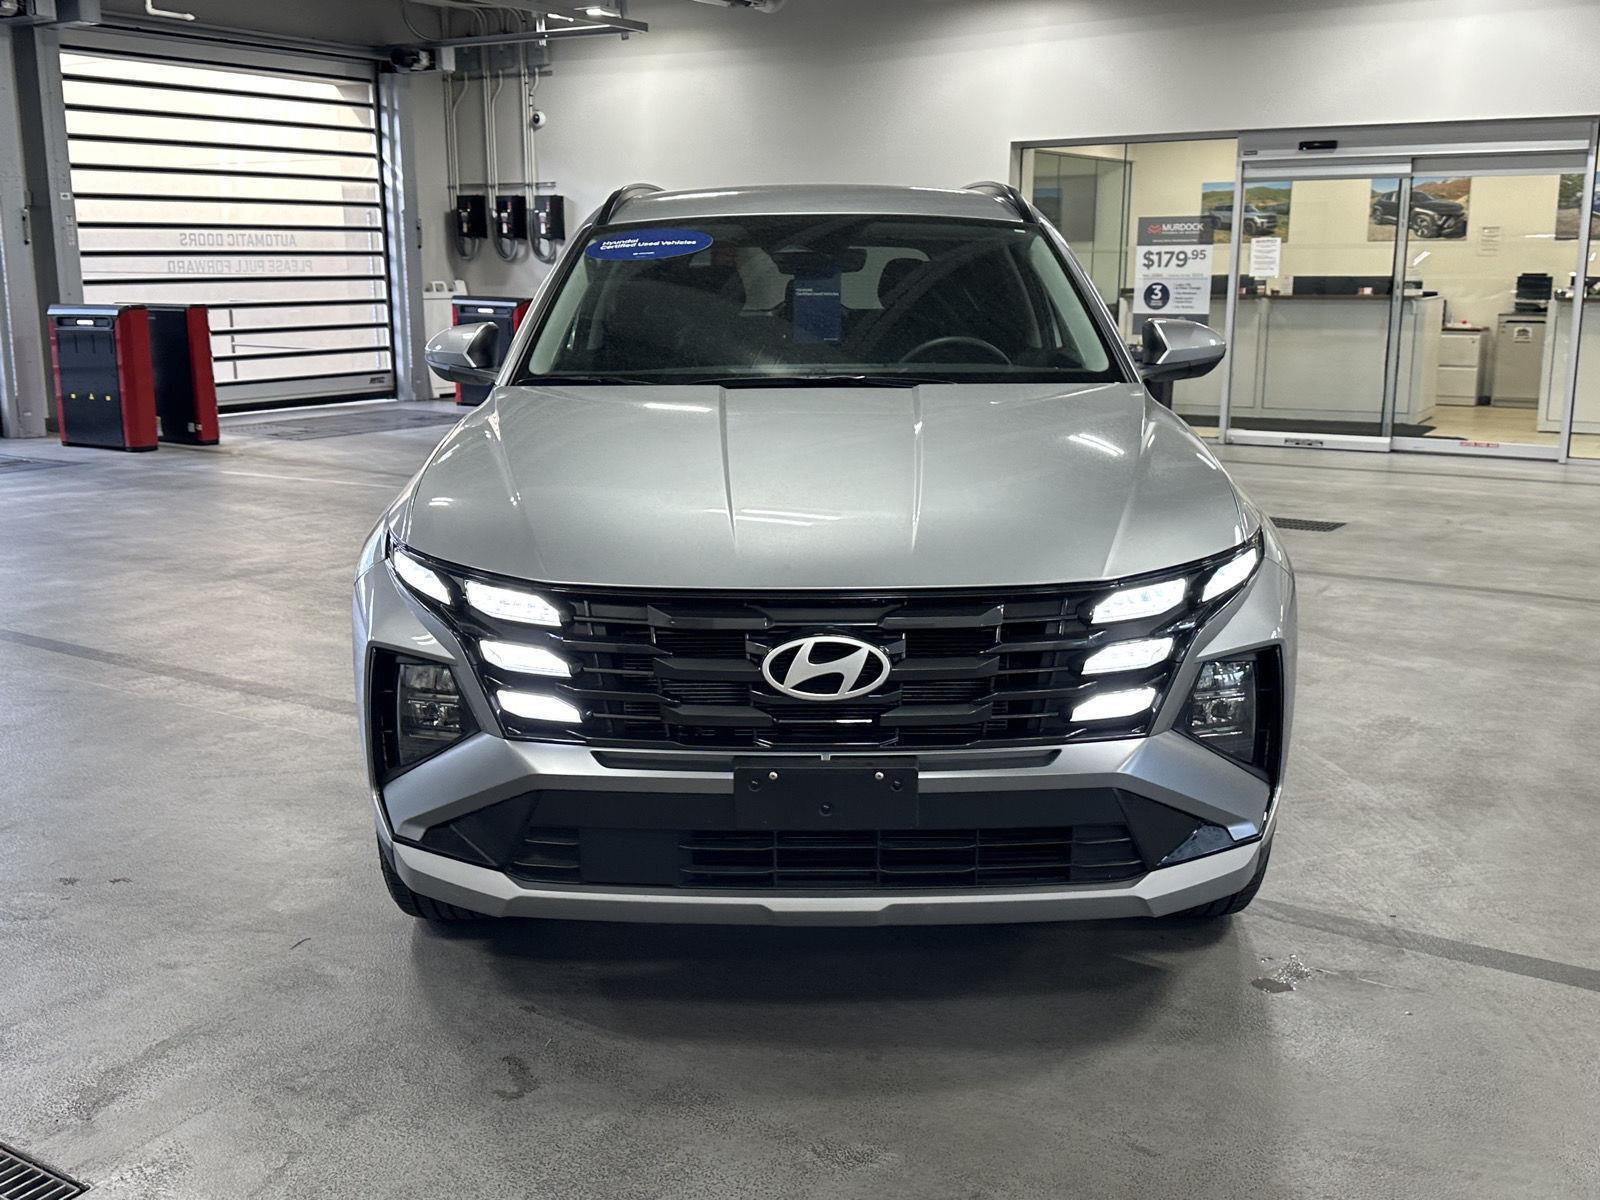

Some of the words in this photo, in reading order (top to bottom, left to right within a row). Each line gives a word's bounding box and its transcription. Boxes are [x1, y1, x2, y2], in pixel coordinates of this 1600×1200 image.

[1162, 223, 1205, 231] MURDOCK
[600, 242, 637, 250] Certified
[602, 238, 640, 247] Hyundai
[1143, 249, 1207, 269] $179.95
[1151, 284, 1163, 300] 3
